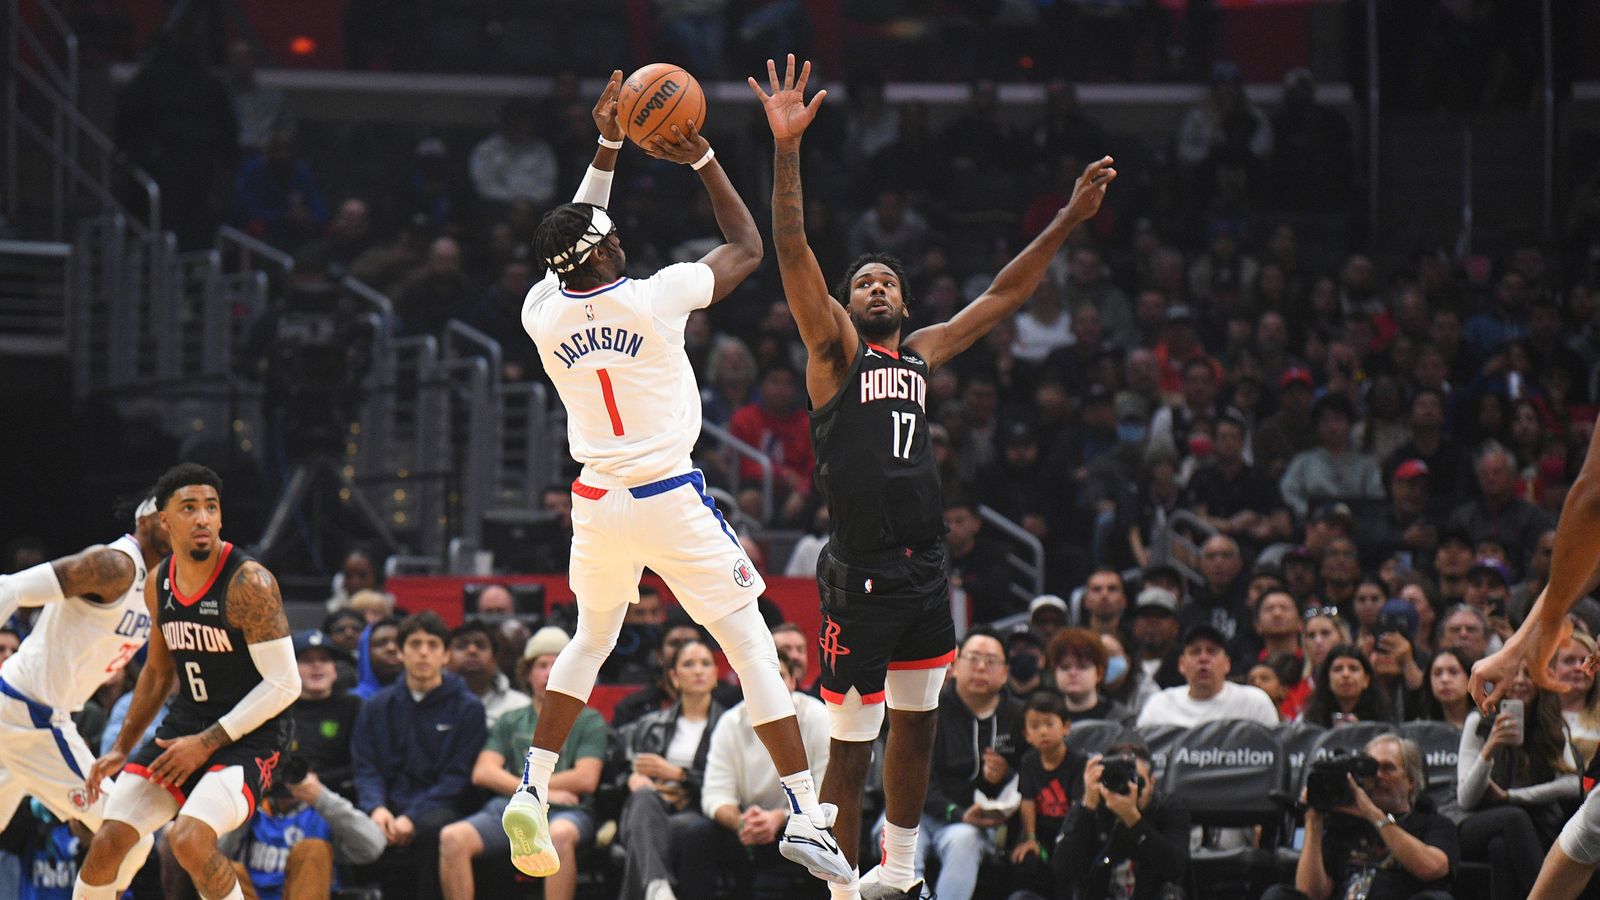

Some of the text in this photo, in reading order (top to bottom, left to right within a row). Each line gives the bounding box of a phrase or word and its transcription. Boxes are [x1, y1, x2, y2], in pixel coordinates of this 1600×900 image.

[634, 80, 680, 127] Wilson
[553, 327, 644, 369] JACKSON
[596, 368, 625, 437] 1
[861, 367, 927, 414] HOUSTO
[891, 410, 916, 459] 17
[162, 621, 233, 652] HOUSTON
[185, 661, 209, 702] 6
[1176, 746, 1275, 768] Aspiration
